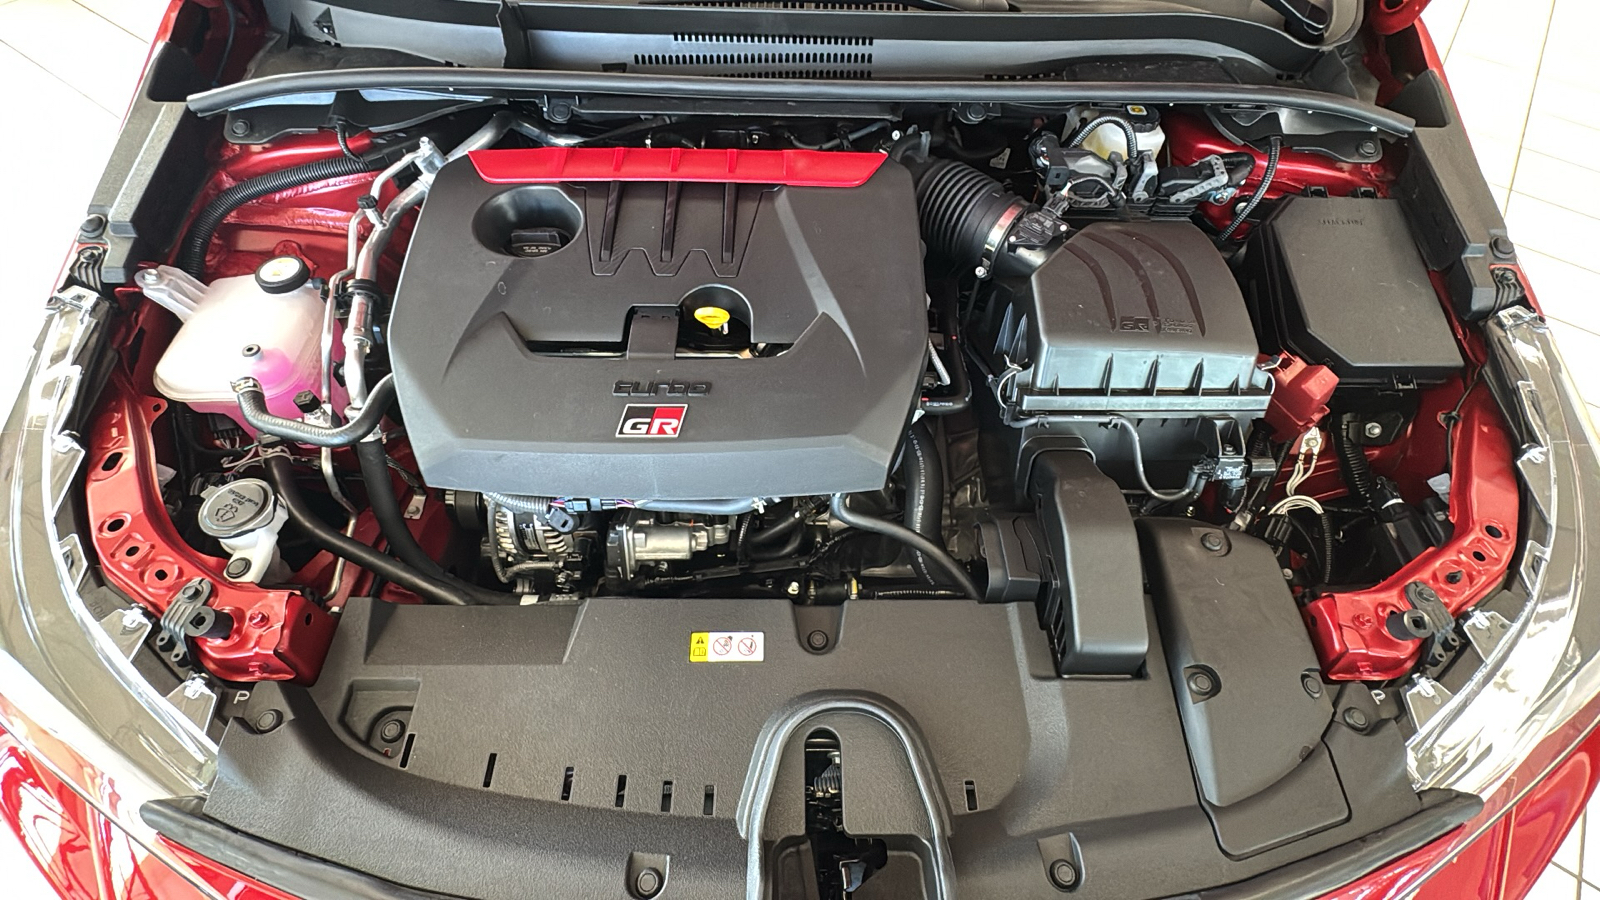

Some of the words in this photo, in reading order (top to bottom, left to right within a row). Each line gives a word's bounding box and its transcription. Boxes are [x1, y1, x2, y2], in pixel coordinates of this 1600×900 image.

[612, 379, 712, 397] turbo
[622, 418, 680, 435] GR
[233, 690, 250, 704] P
[1370, 689, 1386, 705] P
